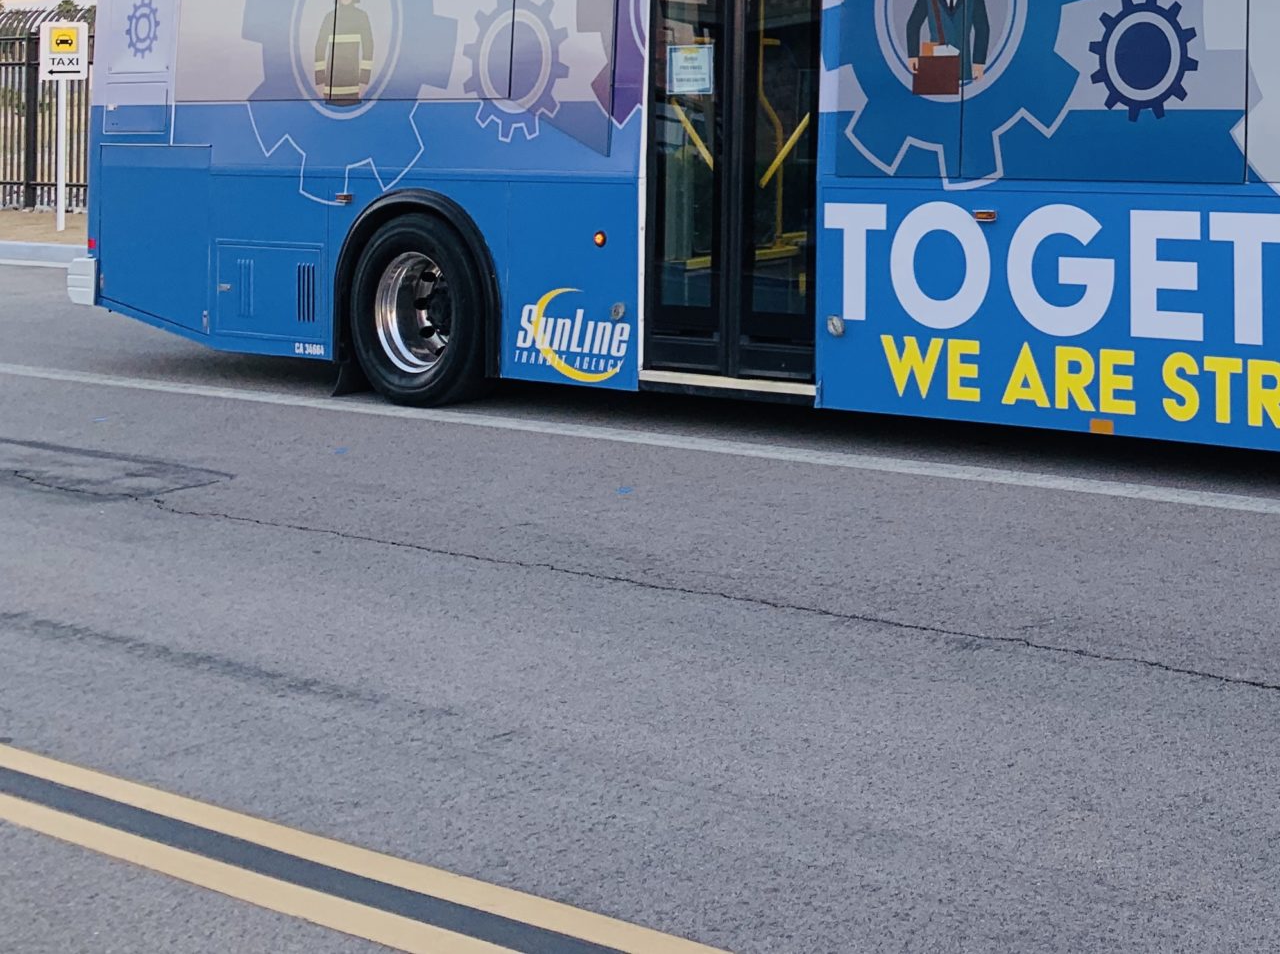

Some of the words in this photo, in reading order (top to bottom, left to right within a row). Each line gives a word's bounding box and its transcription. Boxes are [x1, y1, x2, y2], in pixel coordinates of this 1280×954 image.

[49, 57, 79, 66] TAXI
[294, 342, 304, 354] CA
[574, 356, 624, 373] AGENCY
[880, 334, 980, 402] WE
[1001, 341, 1136, 415] ARE
